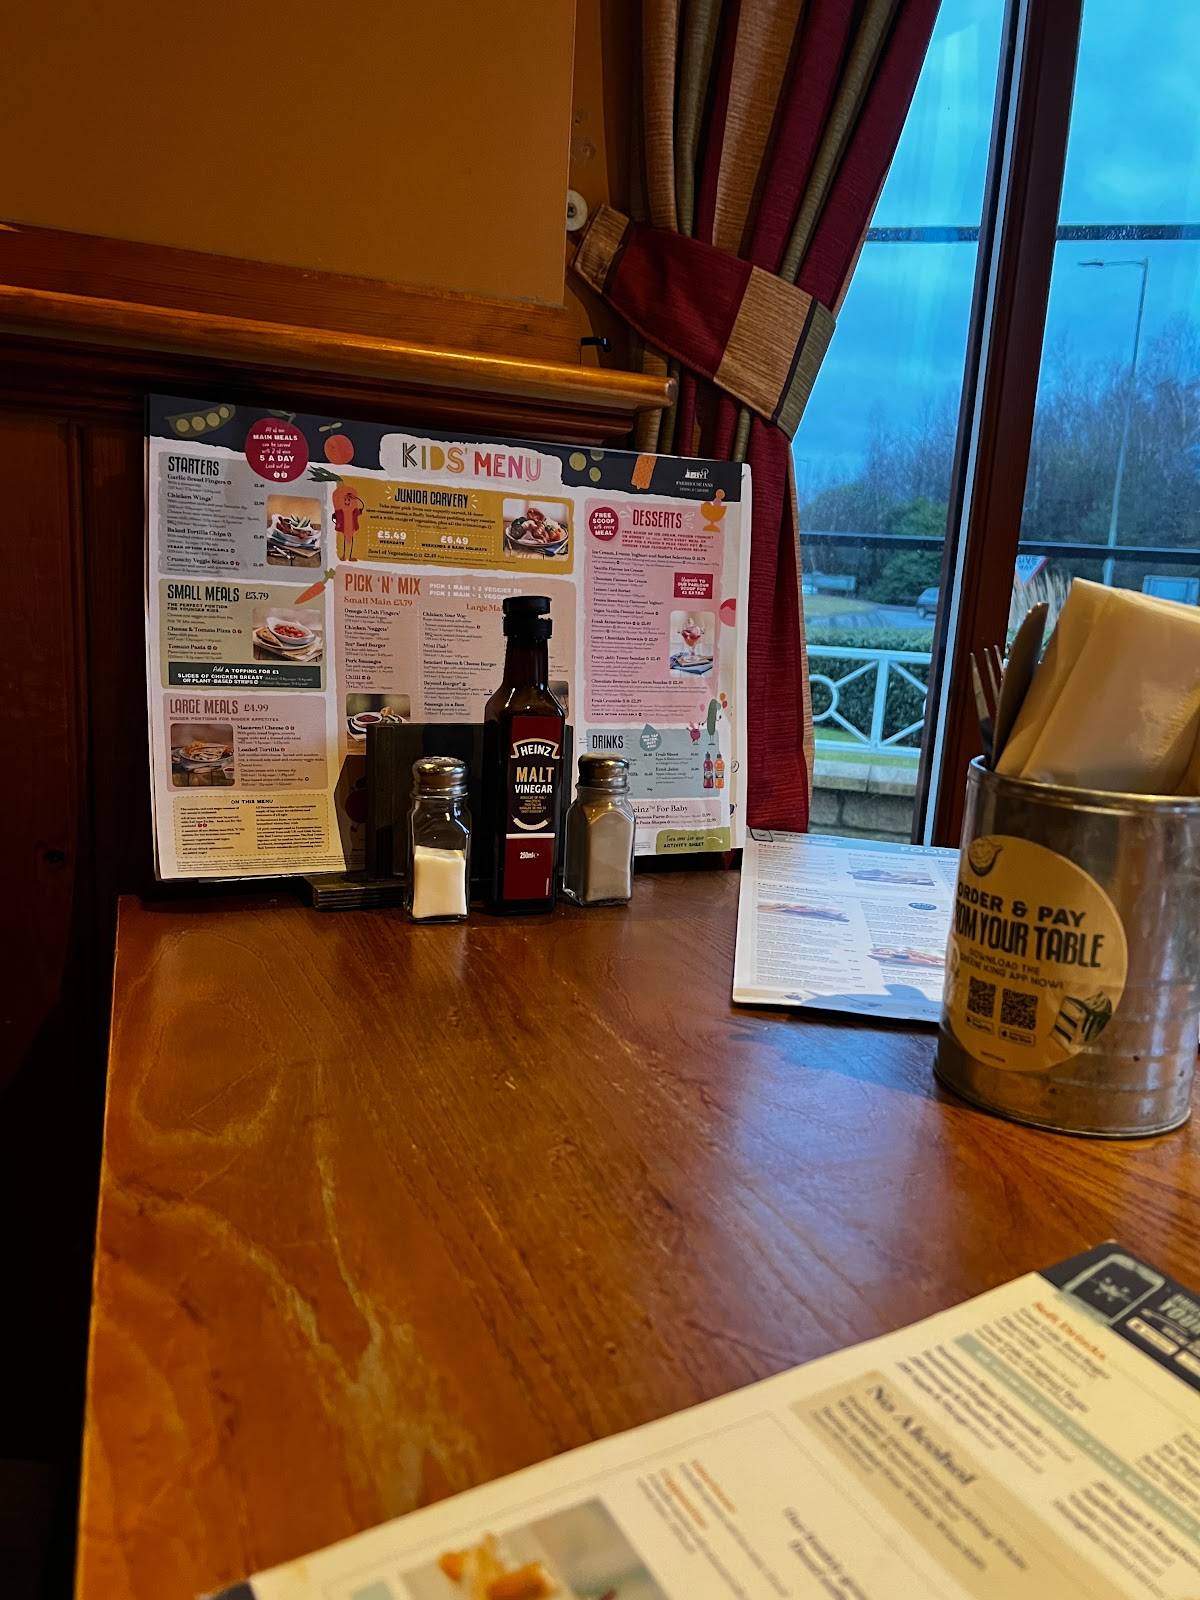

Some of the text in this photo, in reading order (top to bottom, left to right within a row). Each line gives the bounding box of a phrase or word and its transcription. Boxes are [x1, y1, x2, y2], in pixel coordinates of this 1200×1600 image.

[168, 456, 219, 476] STARTERS
[402, 442, 542, 482] KIDS' MENU
[394, 488, 468, 508] JUNIOR CARVERY
[633, 509, 682, 528] DESSERTS
[377, 530, 407, 540] £5.49
[440, 535, 469, 545] £6.49
[344, 574, 372, 593] PICK
[398, 577, 421, 596] MIX
[168, 584, 269, 602] SMALL MEALS £3.79
[344, 596, 367, 605] Small
[369, 598, 392, 606] Main
[466, 603, 488, 612] Large
[170, 698, 269, 714] LARGE MEALS £4.99
[592, 735, 624, 749] DRINKS
[520, 744, 551, 757] HEINZ
[516, 767, 554, 782] MALT
[515, 784, 552, 793] VINEGAR
[671, 805, 688, 813] Baby
[958, 882, 1086, 927] ORDER & PAY
[980, 912, 1029, 957] YOUR
[1034, 926, 1104, 968] TABLE
[983, 963, 1006, 978] KING
[1009, 971, 1028, 982] APP
[1031, 975, 1064, 988] NOW!
[1022, 963, 1040, 975] THE
